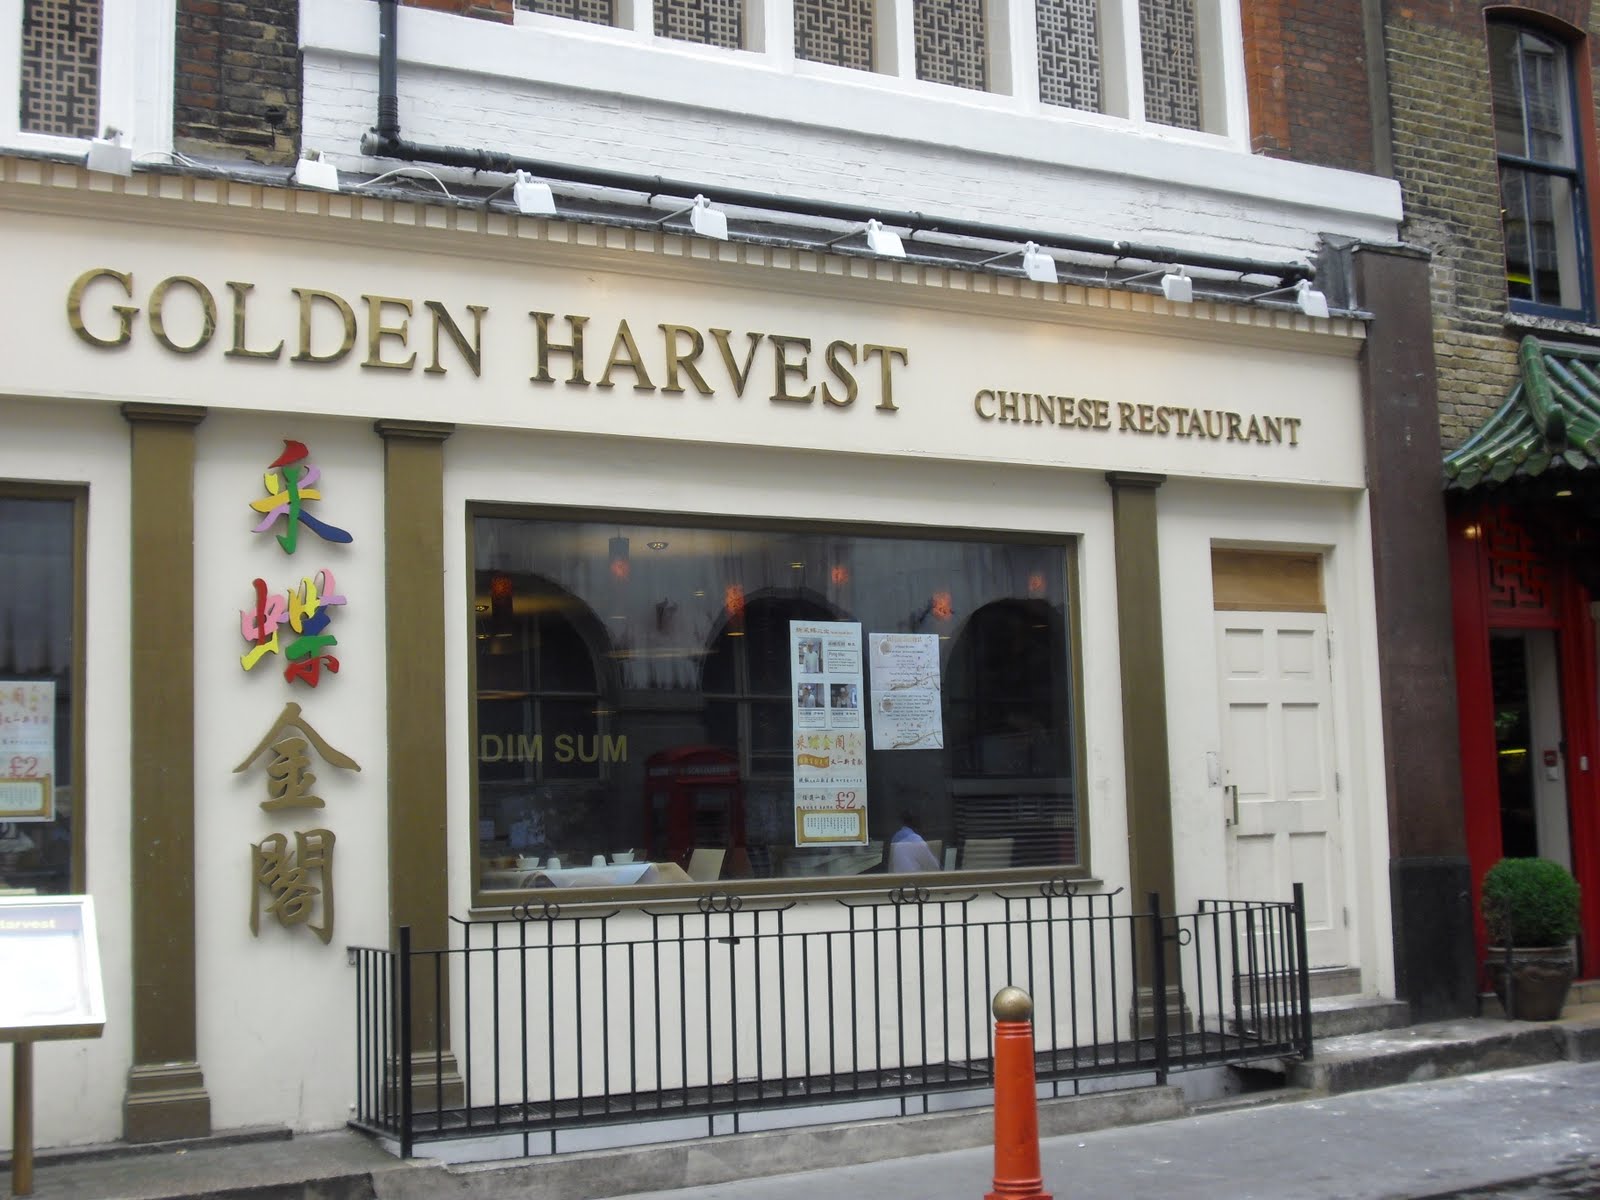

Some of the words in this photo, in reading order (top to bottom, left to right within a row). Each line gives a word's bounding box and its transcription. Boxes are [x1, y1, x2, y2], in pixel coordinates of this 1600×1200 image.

[66, 267, 488, 377] GOLDEN
[528, 311, 908, 411] HARVEST
[973, 388, 1111, 430] CHINESE
[1117, 401, 1301, 446] RESTAURANT
[480, 734, 543, 763] DIM
[554, 734, 628, 763] SUM
[8, 755, 38, 777] £2
[835, 791, 857, 810] £2
